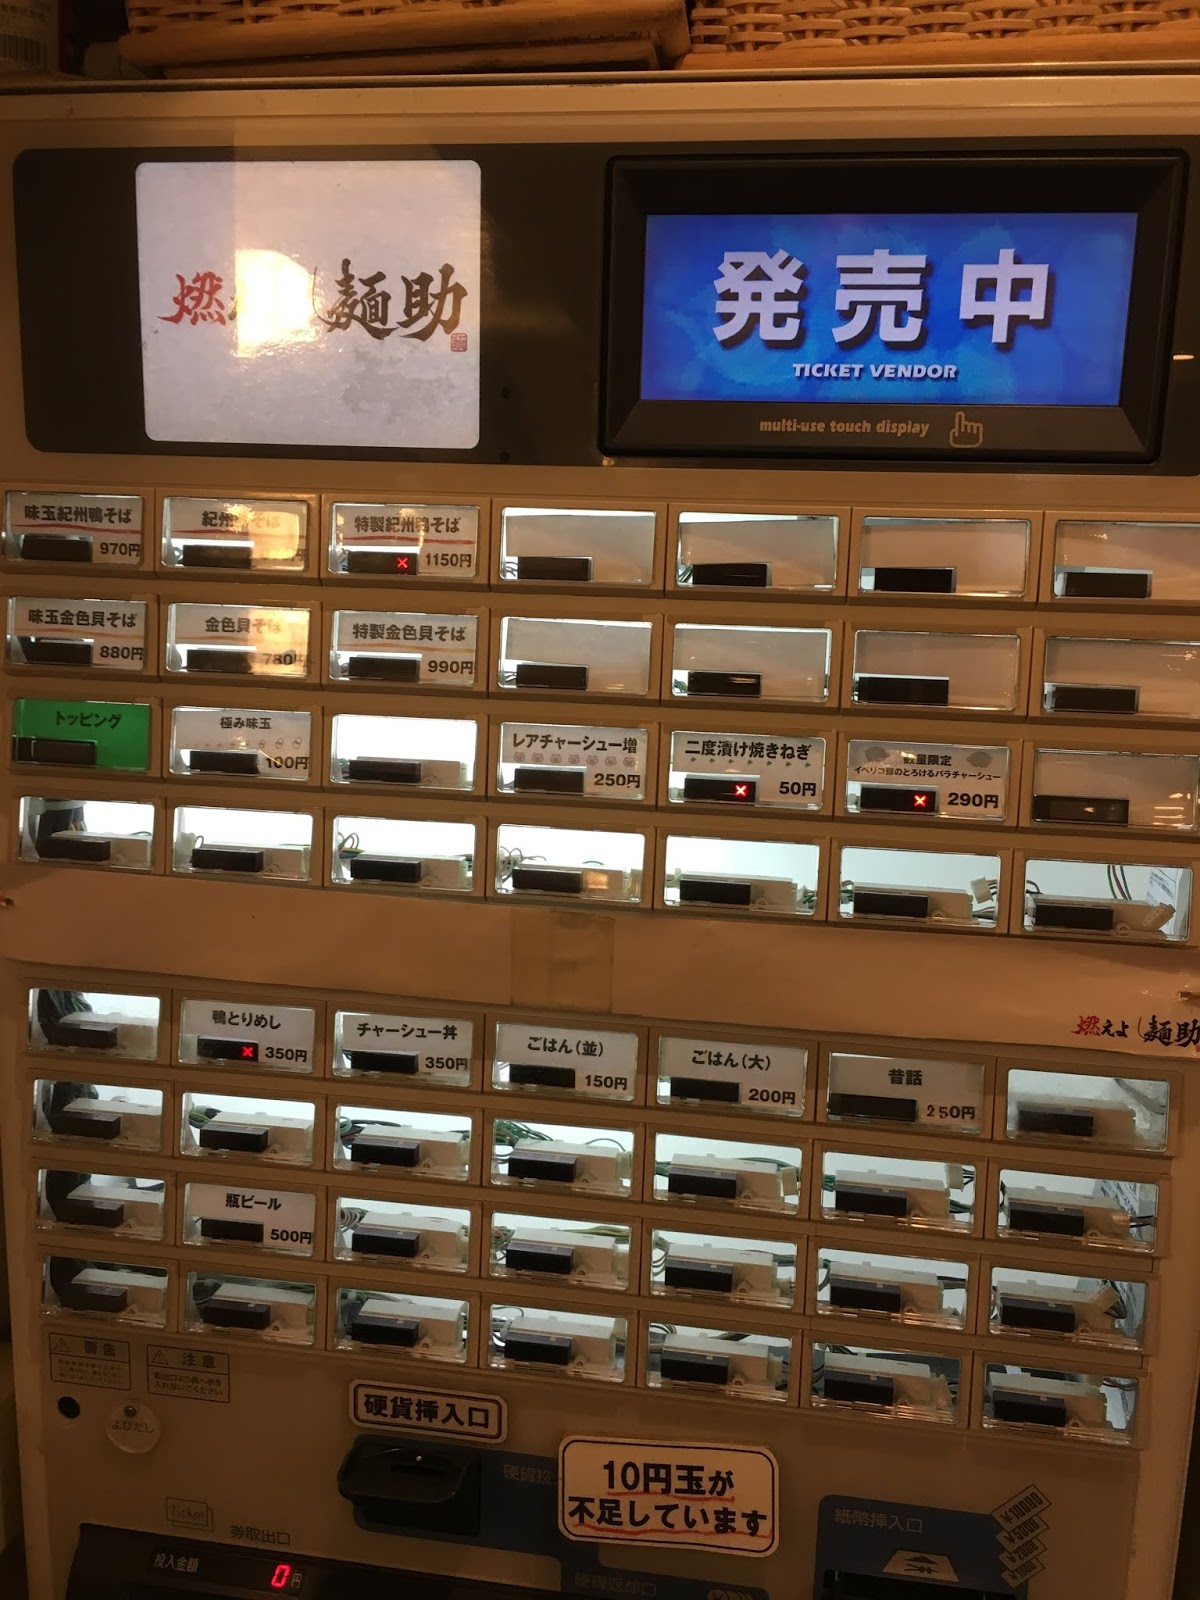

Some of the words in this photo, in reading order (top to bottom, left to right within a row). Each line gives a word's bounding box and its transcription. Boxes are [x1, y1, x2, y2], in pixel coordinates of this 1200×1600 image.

[156, 258, 468, 342] 燃麺助
[713, 248, 1050, 344] 発売中
[793, 363, 863, 378] TICKET
[870, 364, 958, 380] VENDOR
[759, 418, 825, 433] multi-use
[830, 420, 871, 434] touch
[876, 420, 930, 437] display
[24, 504, 133, 524] 味玉紀州鴨そば
[354, 515, 461, 534] 特製紀州鴨そば
[100, 542, 141, 557] 970円
[424, 553, 472, 568] 1150円
[28, 608, 137, 628] 味玉金色貝そば
[352, 622, 467, 642] 特製金色貝そば
[100, 645, 144, 661] 880円
[427, 660, 474, 676] 990円
[55, 710, 123, 729] トッピング
[219, 716, 272, 731] 極み味玉
[512, 732, 638, 754] レアチャーシュー増
[684, 740, 813, 760] 二度漬け焼きねぎ
[265, 755, 309, 770] 100円
[593, 772, 641, 789] 250円
[778, 781, 817, 797] 50円
[947, 792, 999, 810] 290円
[212, 1009, 282, 1029] 鴨とりめし
[356, 1022, 458, 1041] チャーシュー丼
[265, 1046, 308, 1063] 350円
[425, 1056, 470, 1071] 350円
[584, 1074, 629, 1091] 150円
[888, 1068, 924, 1087] 昔話
[748, 1088, 797, 1105] 200円
[926, 1103, 977, 1121] 250円
[225, 1192, 283, 1212] 瓶ビール
[270, 1228, 313, 1245] 500円
[363, 1393, 490, 1429] 硬貨挿入口
[603, 1460, 735, 1497] 10円玉が
[170, 1504, 205, 1519] Ticket
[567, 1496, 768, 1537] 不足しています
[154, 1553, 200, 1574] 投入金額
